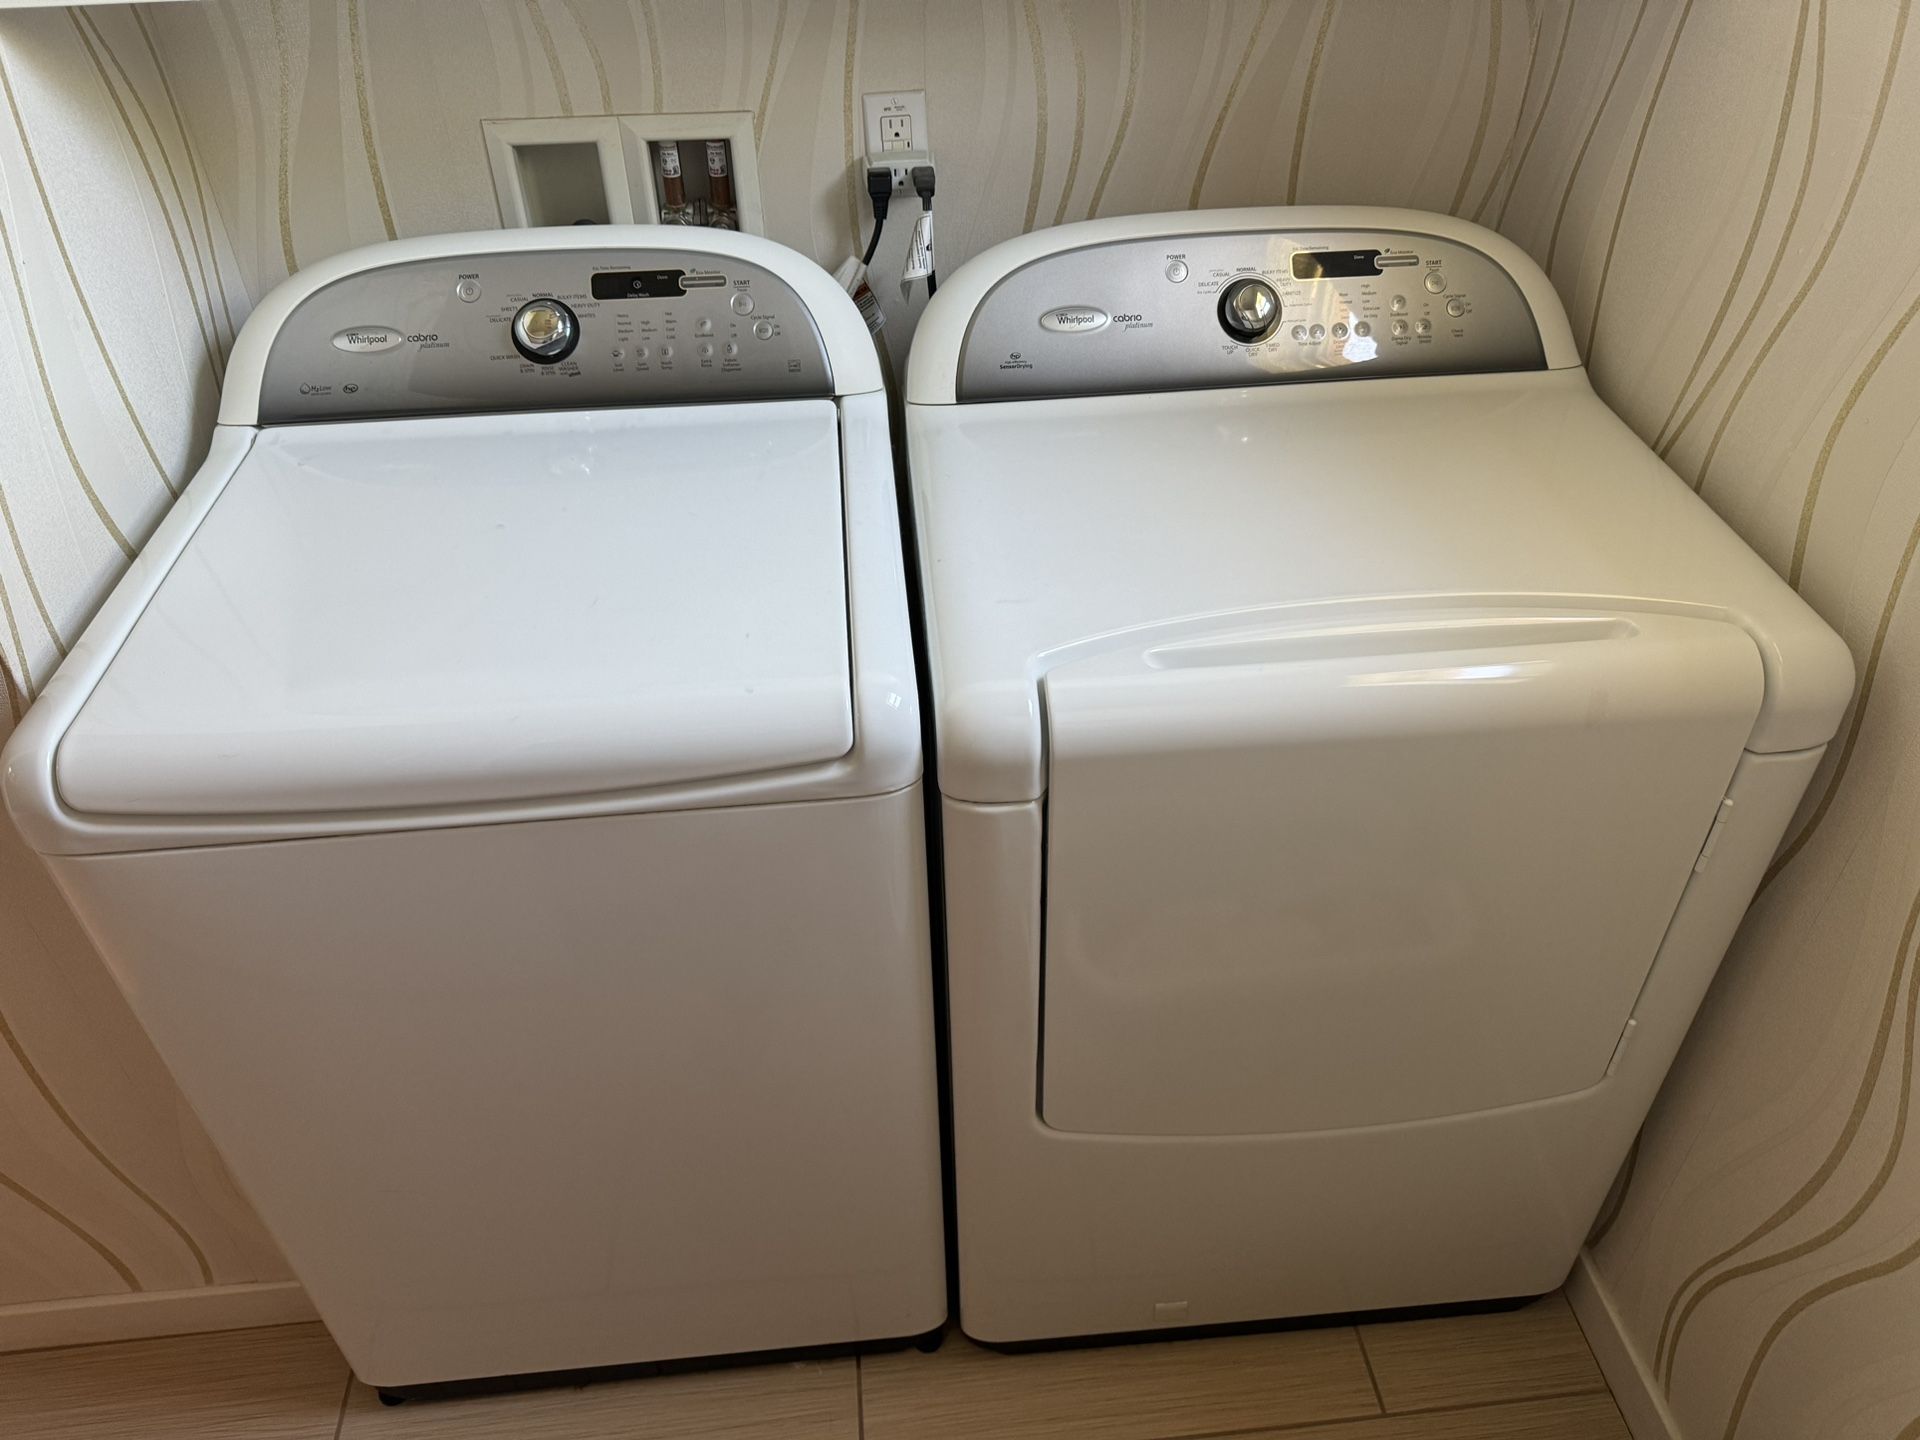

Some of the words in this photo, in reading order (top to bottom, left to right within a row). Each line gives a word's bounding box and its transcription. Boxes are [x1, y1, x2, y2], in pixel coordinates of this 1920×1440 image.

[1057, 314, 1094, 325] Whirlpool
[1112, 314, 1142, 322] cabrio
[1124, 322, 1153, 331] platinum
[346, 334, 388, 345] Whirlpool
[407, 334, 438, 343] cabrio
[418, 342, 450, 352] platinum
